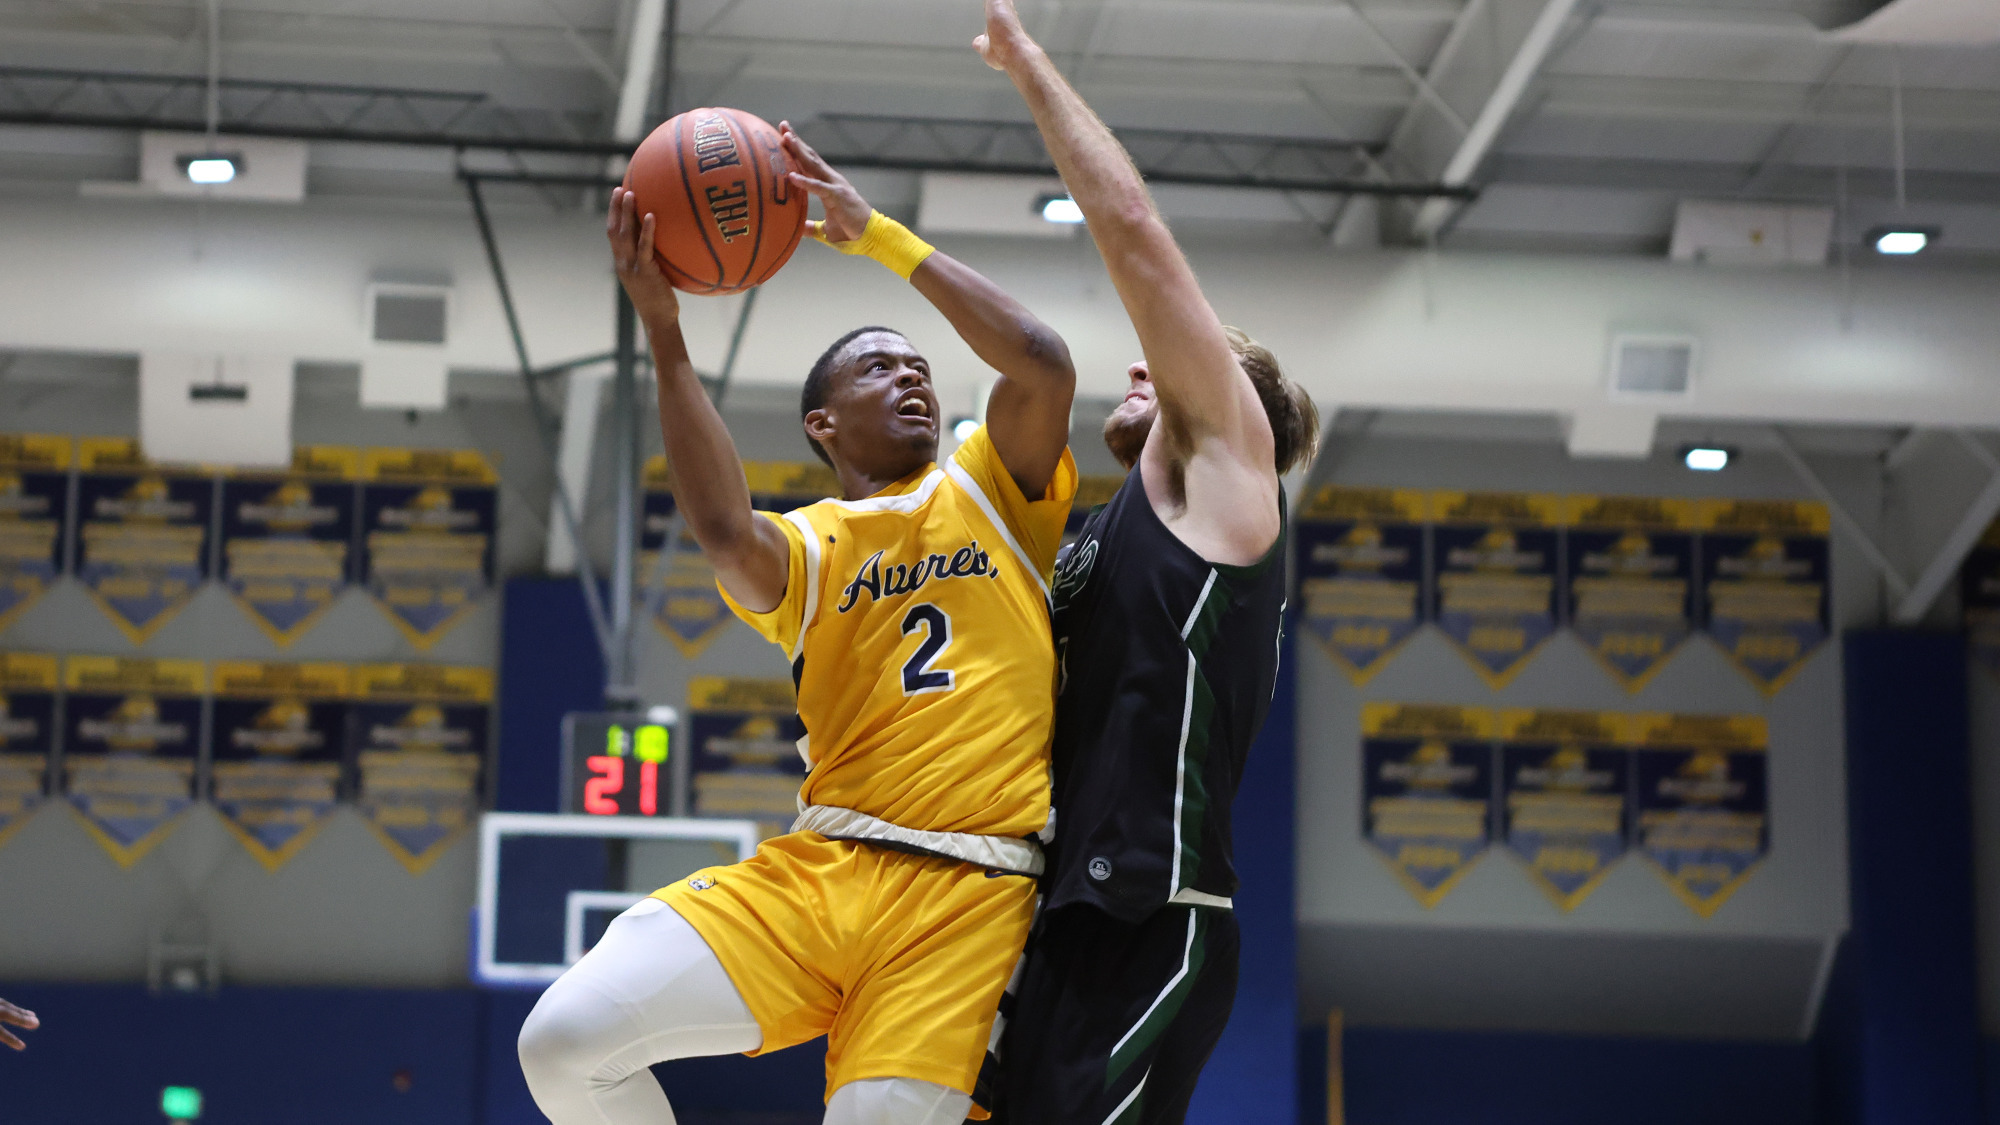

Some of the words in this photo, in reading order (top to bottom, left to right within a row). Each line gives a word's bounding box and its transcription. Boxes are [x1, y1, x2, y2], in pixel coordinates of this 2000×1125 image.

[694, 111, 742, 175] ROCK
[705, 178, 749, 243] THE
[900, 600, 956, 697] 2
[584, 755, 659, 817] 21
